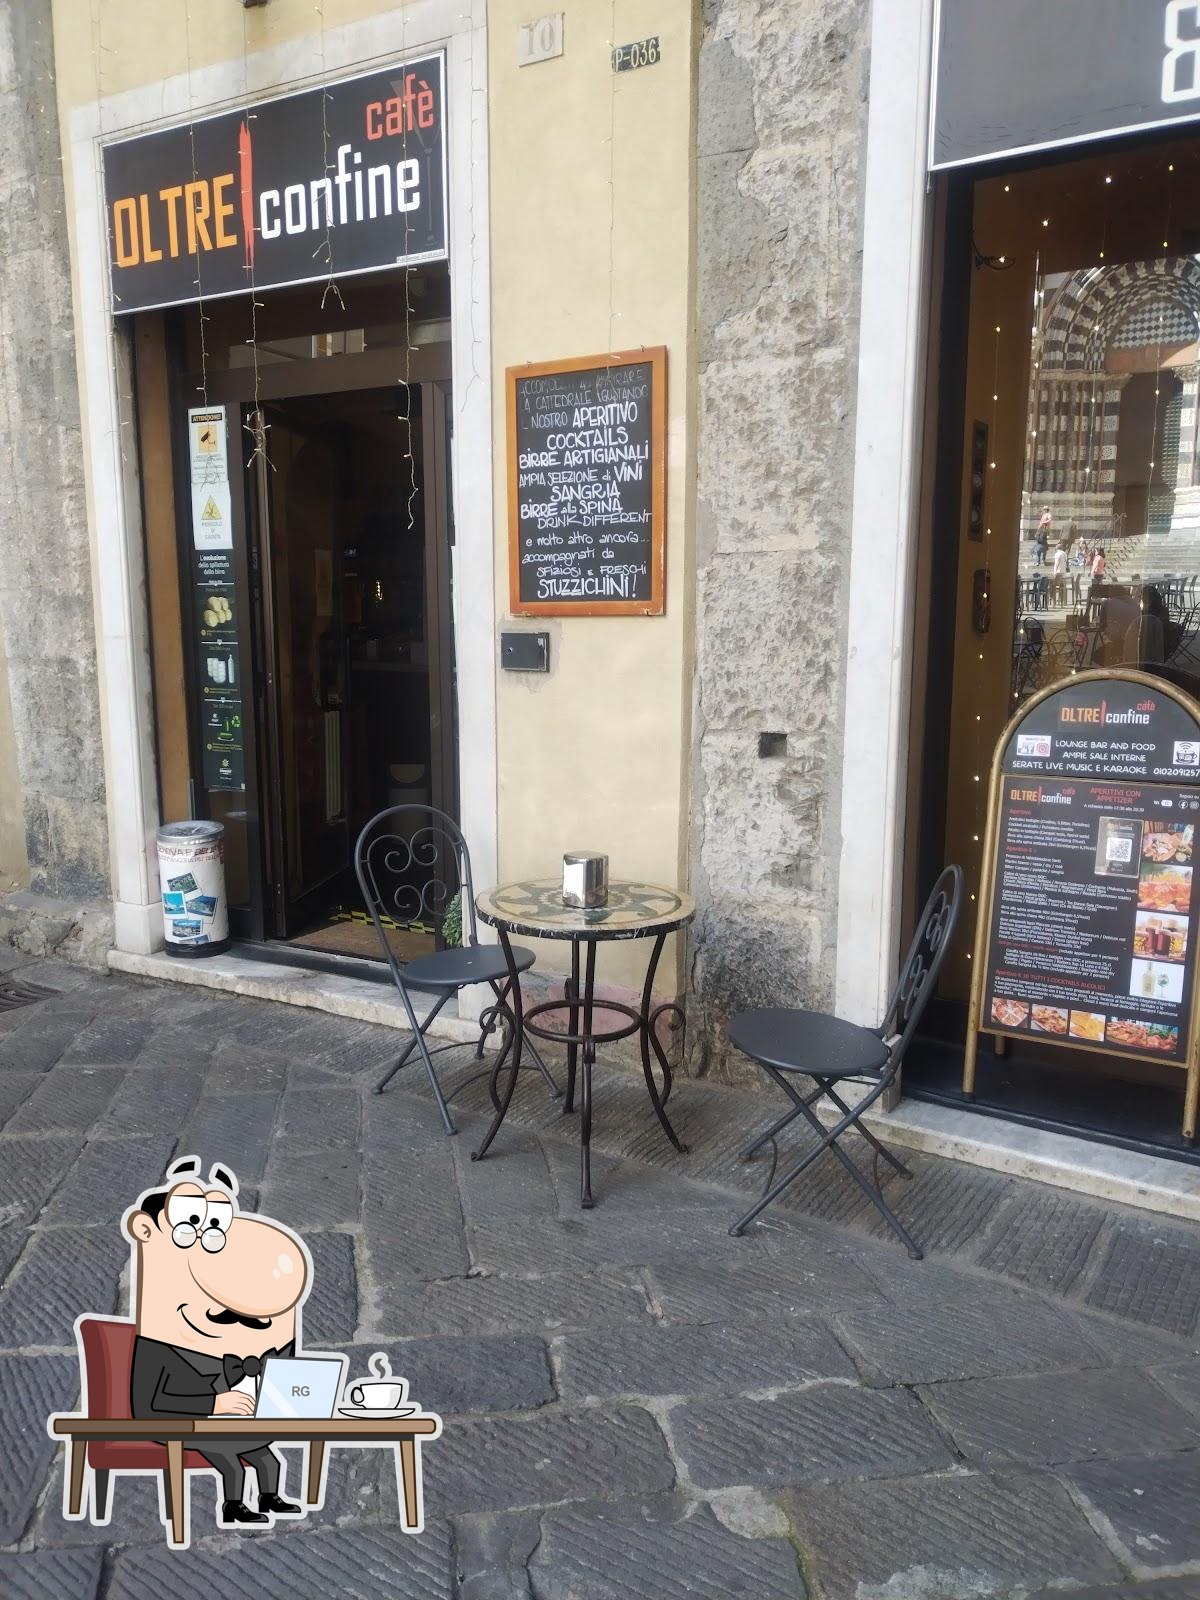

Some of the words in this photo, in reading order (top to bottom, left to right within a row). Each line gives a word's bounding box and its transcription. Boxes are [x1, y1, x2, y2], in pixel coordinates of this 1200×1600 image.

[521, 22, 554, 56] 10
[615, 38, 657, 72] P-036
[366, 73, 434, 141] cafè
[113, 173, 238, 268] OLTRE
[259, 143, 420, 240] confine
[535, 390, 592, 411] CATTEDRALE
[531, 411, 568, 429] NOSTRO
[572, 400, 638, 428] APERITIVO
[546, 425, 629, 450] COCKTAILS
[519, 448, 561, 469] BIRRE
[563, 440, 649, 468] ARTIGIANALI
[519, 471, 546, 489] AMPIA
[547, 467, 598, 486] SELEZIONE
[601, 469, 612, 481] di
[550, 479, 621, 502] SANGRIA
[520, 498, 559, 520] BIRRE
[579, 498, 624, 515] SPINA
[537, 515, 583, 530] DRINK
[582, 509, 653, 527] DIFFERENT
[526, 538, 533, 547] e
[537, 533, 564, 547] molto
[567, 531, 594, 545] altro
[521, 547, 596, 567] accompagnati
[601, 547, 615, 559] da
[1061, 707, 1101, 723] OLTRE
[1105, 708, 1150, 725] confine
[1055, 740, 1088, 749] LOUNGE
[1090, 741, 1108, 750] BAR
[1110, 742, 1129, 750] AND
[1131, 743, 1156, 751] FOOD
[1062, 751, 1087, 760] AMPIE
[1089, 752, 1109, 761] SALE
[1110, 753, 1147, 762] INTERNE
[1012, 760, 1043, 769] SERATE
[1045, 761, 1064, 770] LIVE
[1066, 763, 1093, 772] MUSIC
[1095, 764, 1101, 772] E
[1103, 765, 1148, 775] KARAOKE
[1010, 789, 1038, 802] OLTRE
[1041, 792, 1072, 805] confine
